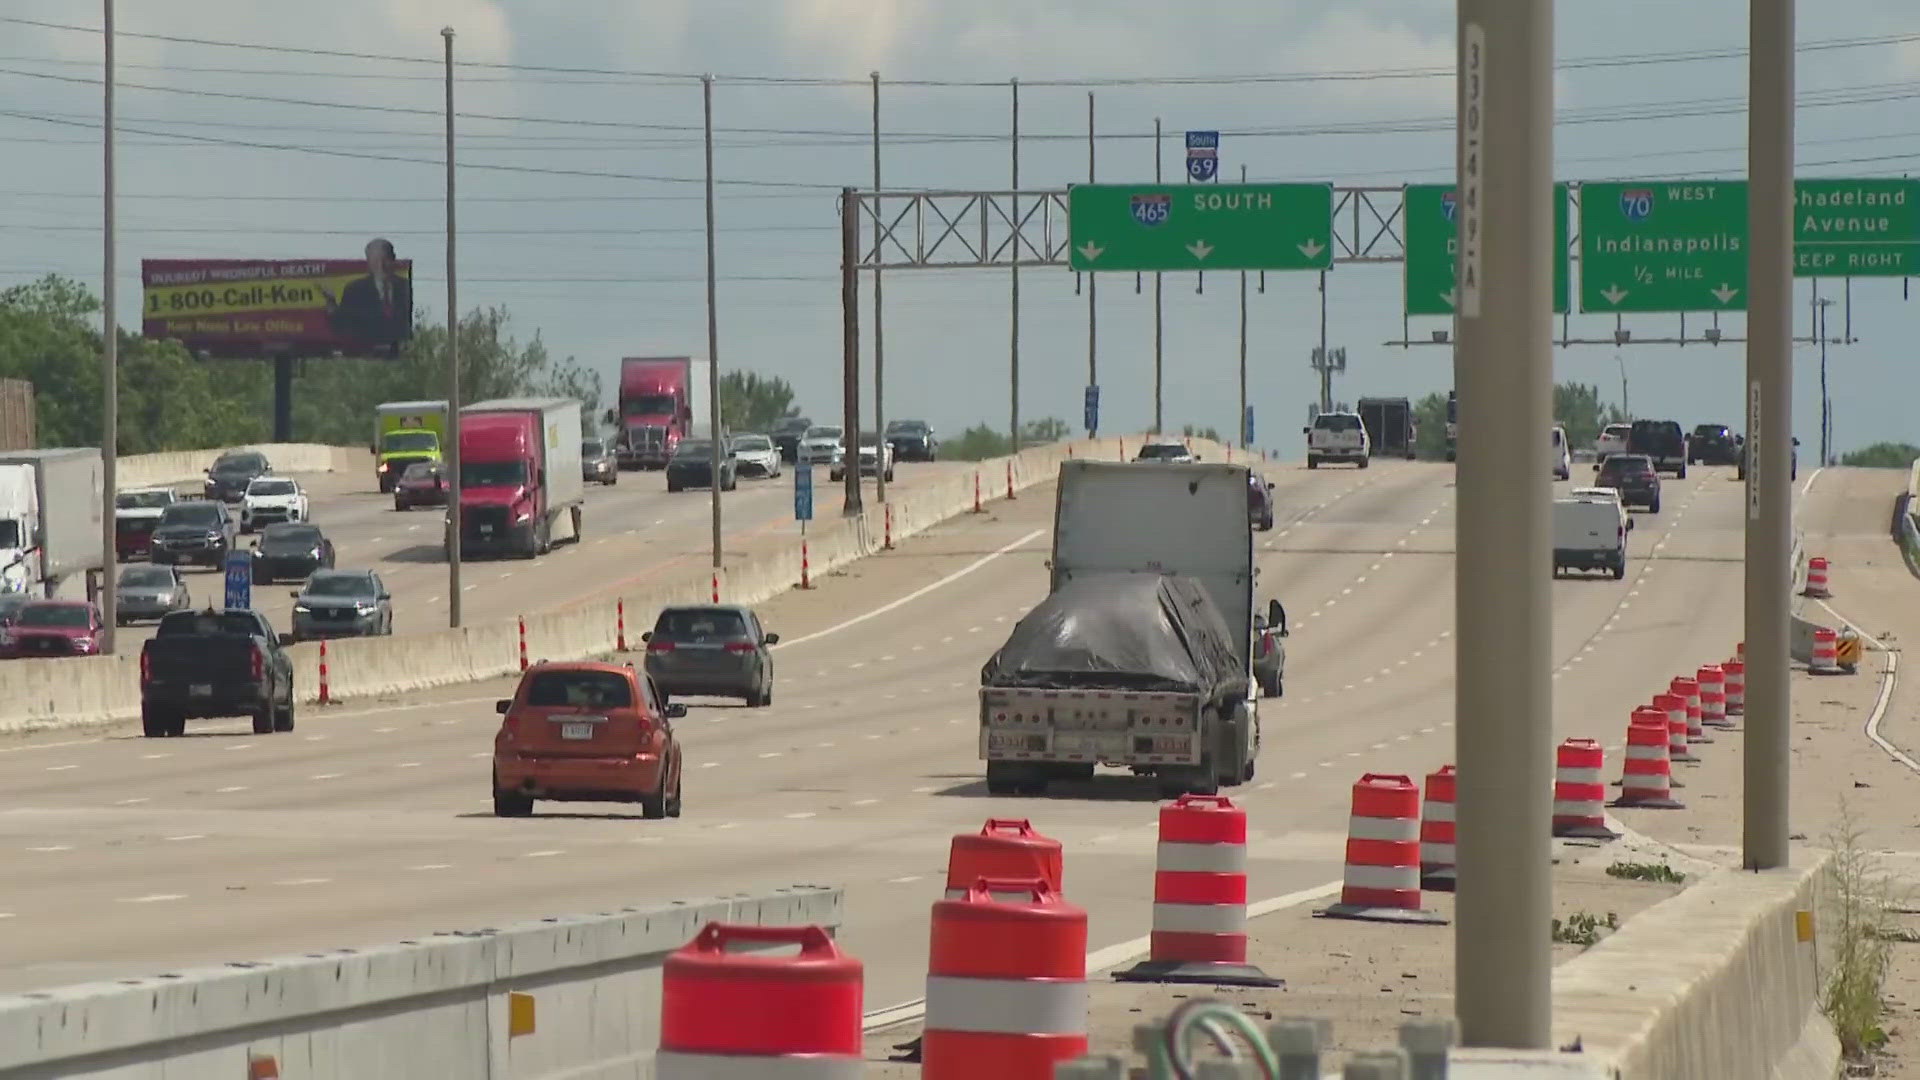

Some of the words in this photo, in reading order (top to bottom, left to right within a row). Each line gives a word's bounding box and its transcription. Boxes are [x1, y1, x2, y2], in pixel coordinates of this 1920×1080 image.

[1191, 158, 1214, 175] 69
[1135, 202, 1168, 221] 465
[1194, 193, 1273, 210] SOUTH
[1624, 197, 1650, 216] 70
[1668, 186, 1716, 200] WEST
[1803, 214, 1890, 232] Avenue
[1596, 233, 1740, 254] Indianapolis
[1793, 252, 1836, 267] EEP
[1849, 252, 1904, 267] RIGHT
[1665, 267, 1704, 279] MILE
